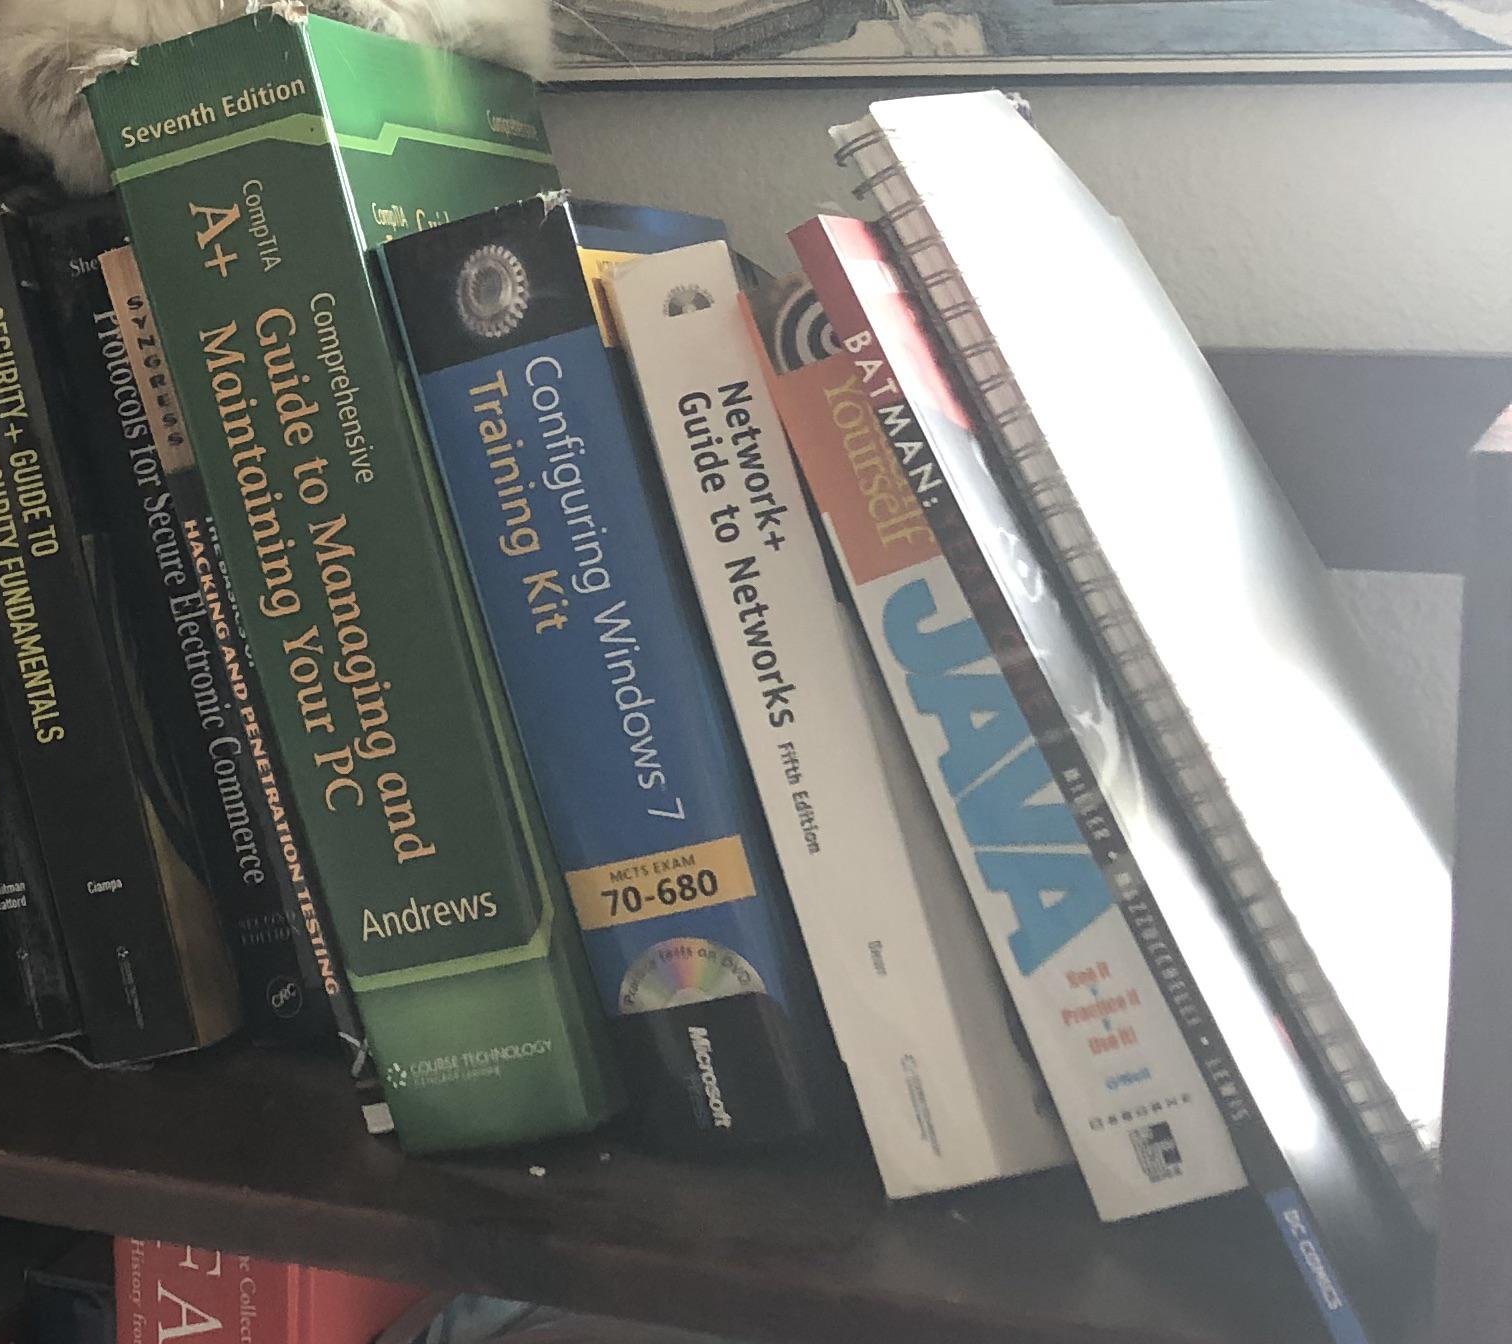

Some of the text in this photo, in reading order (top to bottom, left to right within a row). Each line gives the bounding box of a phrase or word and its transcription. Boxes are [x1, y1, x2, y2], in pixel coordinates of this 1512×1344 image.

[120, 77, 307, 149] Seventh Edition
[188, 200, 243, 279] A+
[241, 178, 284, 275] CompTIA
[126, 295, 185, 448] SYNGRESS
[308, 291, 375, 486] Comprehensive
[843, 329, 940, 509] BATMAN:
[8, 449, 50, 521] GUIDE
[28, 525, 60, 558] TO
[468, 369, 569, 634] Training Kit
[718, 379, 788, 553] Network+
[821, 374, 936, 550] Yourself
[198, 319, 366, 814] Maintaining Your PC
[254, 306, 438, 866] Guide to Managing and
[524, 356, 687, 824] Configuring Windows 7
[678, 391, 821, 855] Guide to Networks Fifth Edition
[143, 492, 274, 888] Secure Electronic Commerce
[183, 518, 341, 997] HACKING AND PENETRATION TESTING
[881, 578, 1118, 978] JAVA
[87, 877, 124, 896] Ciampa
[360, 887, 499, 944] Andrews
[599, 868, 720, 919] 70-680
[609, 853, 697, 885] MCTS EXAM
[687, 1025, 733, 1129] Microsoft
